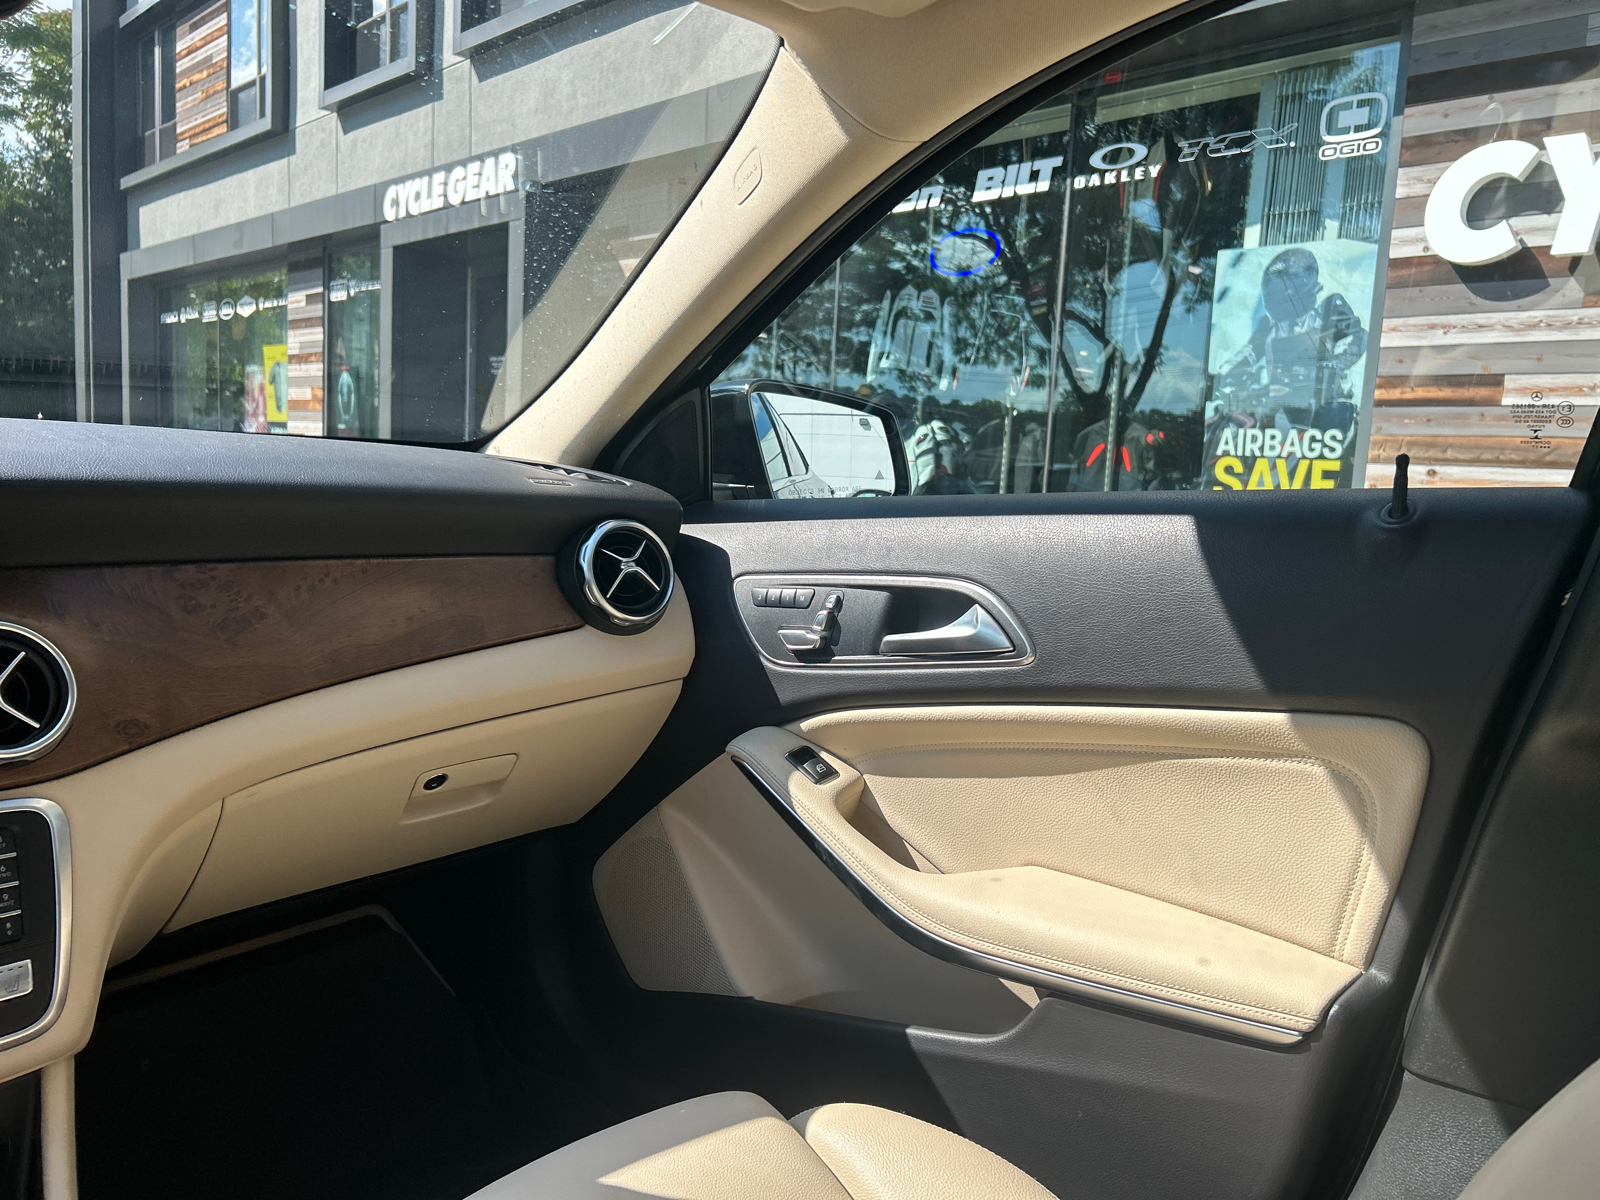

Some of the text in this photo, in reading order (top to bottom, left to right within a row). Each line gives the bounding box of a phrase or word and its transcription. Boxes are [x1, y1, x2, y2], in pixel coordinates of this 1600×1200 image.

[1318, 137, 1383, 161] OGIO
[383, 151, 517, 222] CYCLE GEAR
[971, 156, 1064, 202] BILT
[1073, 163, 1163, 189] OAKLEY
[1216, 428, 1343, 459] AIRBAGS
[1213, 456, 1341, 490] SAVE
